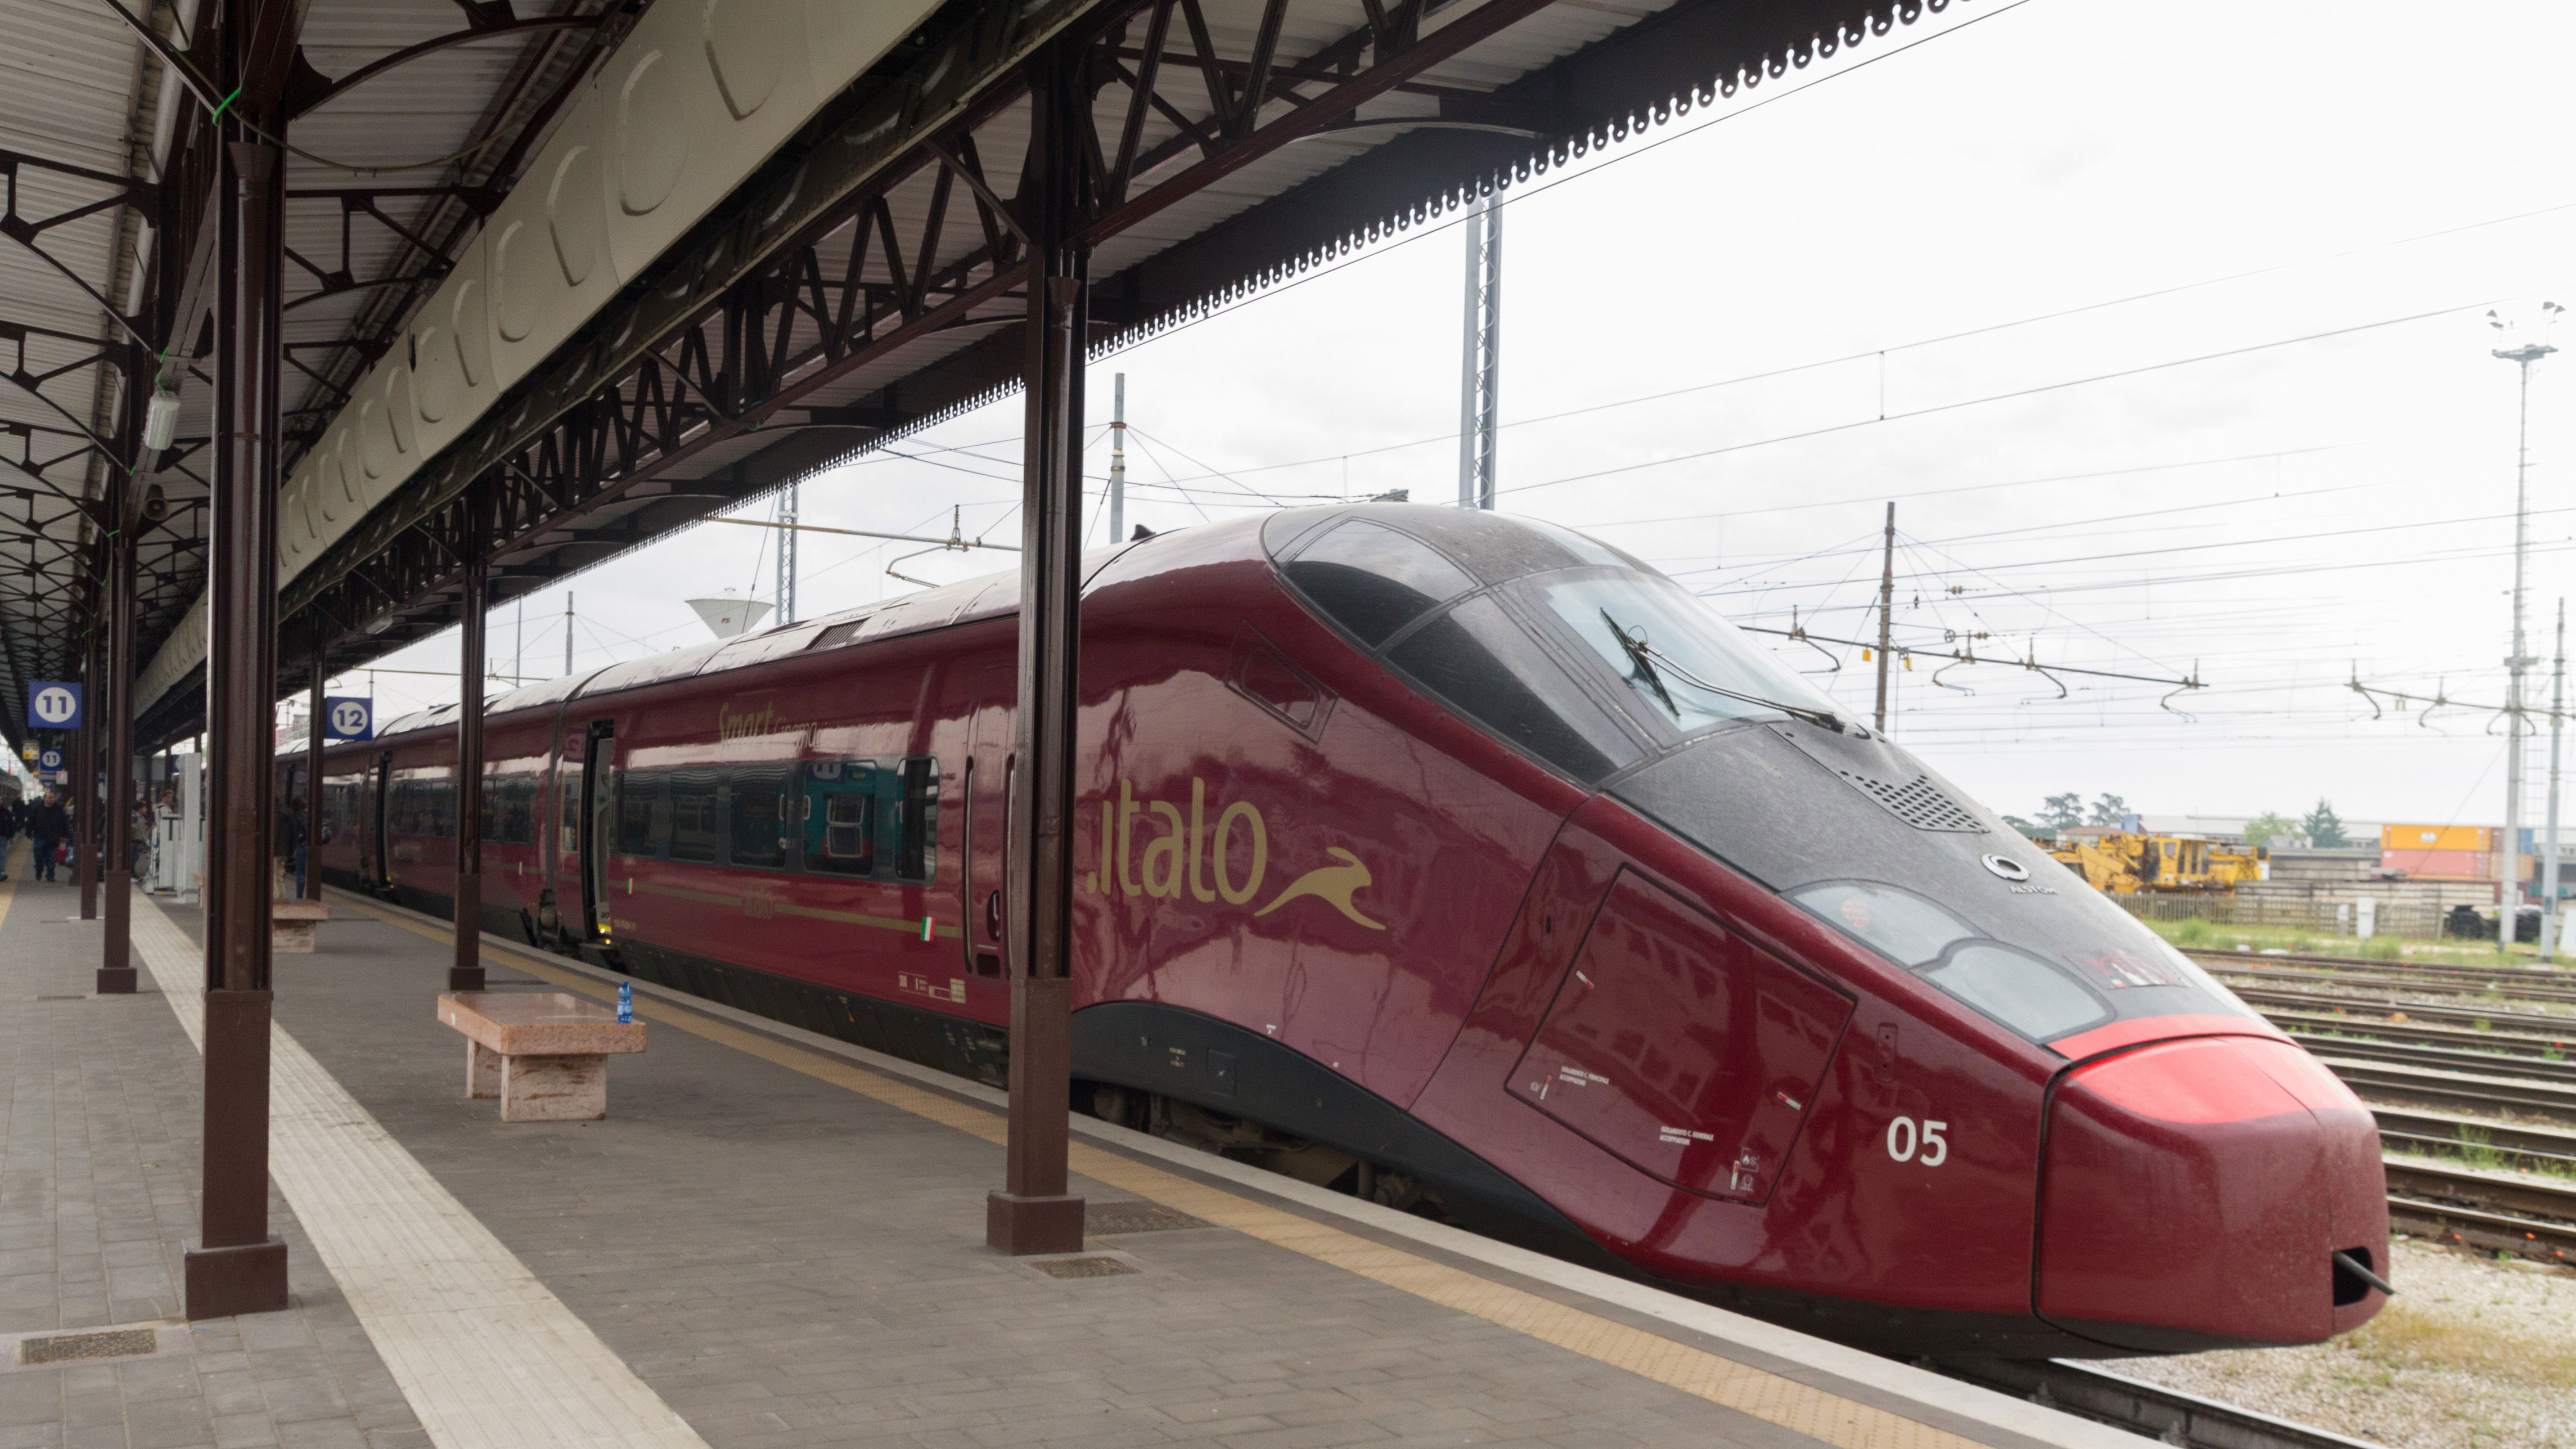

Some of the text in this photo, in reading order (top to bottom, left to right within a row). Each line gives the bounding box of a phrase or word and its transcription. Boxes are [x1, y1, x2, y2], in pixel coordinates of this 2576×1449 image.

[43, 695, 67, 714] 11
[337, 709, 363, 727] 12
[1887, 1116, 1947, 1167] 05
